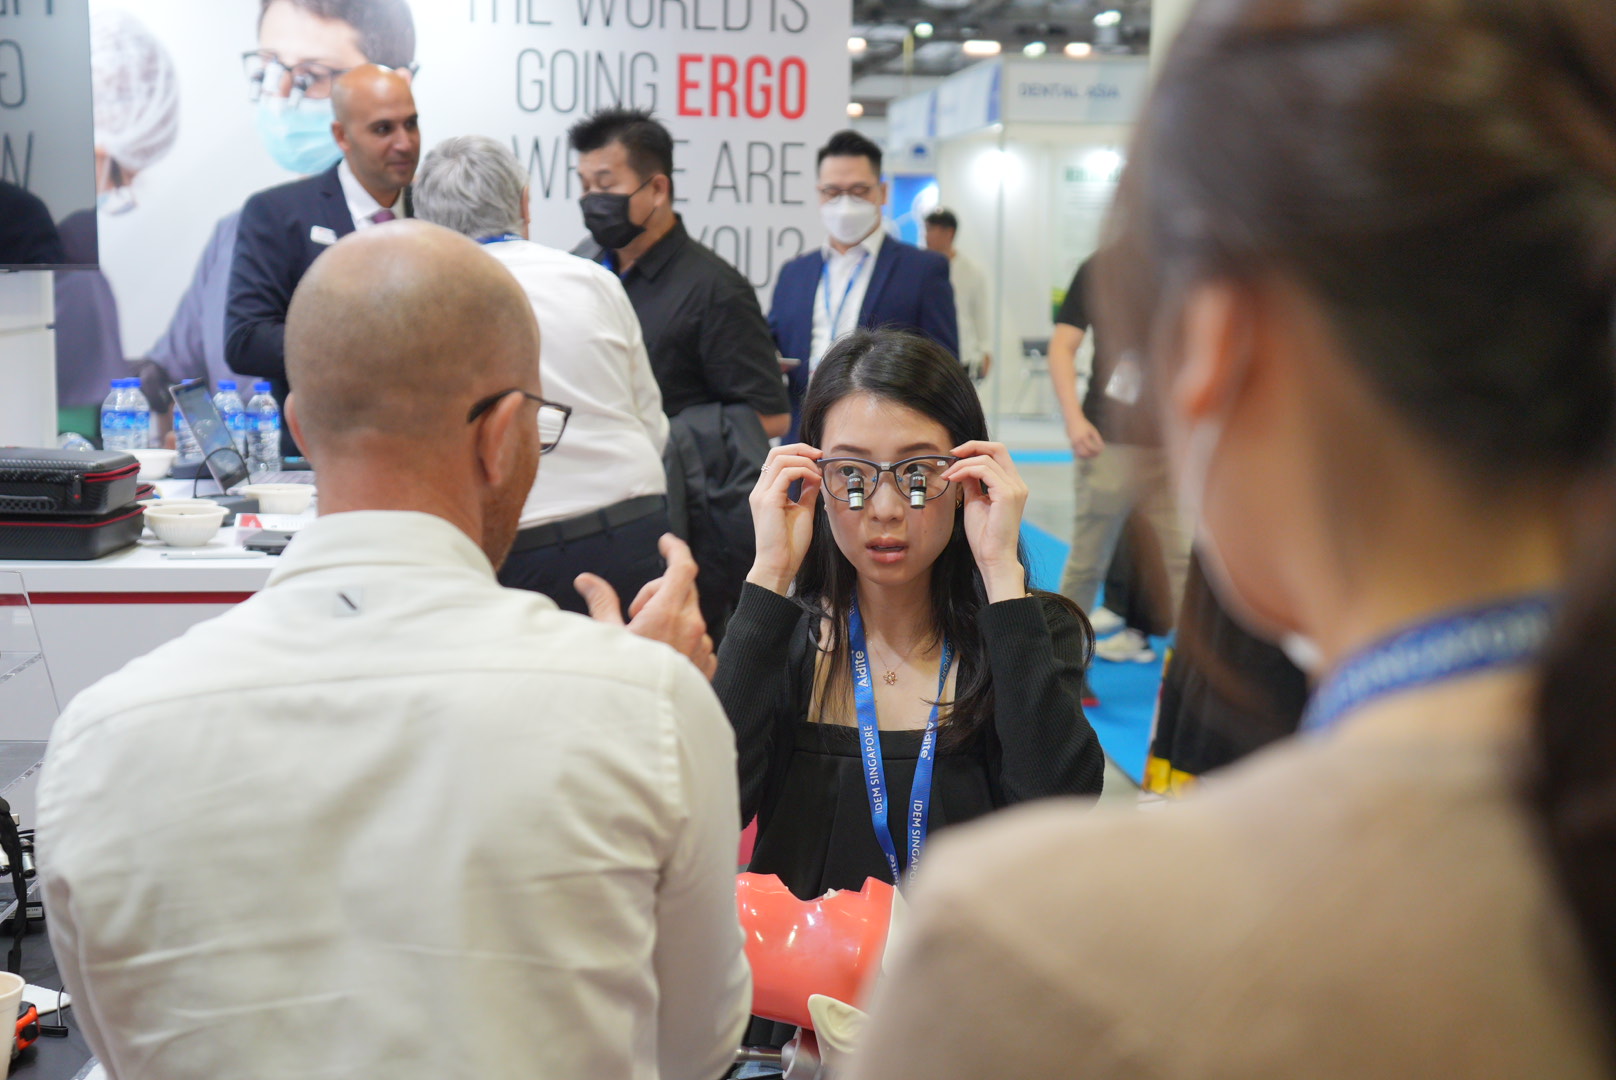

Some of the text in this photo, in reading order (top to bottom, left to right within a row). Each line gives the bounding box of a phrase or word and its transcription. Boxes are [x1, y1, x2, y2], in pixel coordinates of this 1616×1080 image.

[516, 49, 807, 120] GOING ERGO
[708, 140, 806, 205] ARE
[863, 724, 883, 815] IDEM SINGAPORE
[911, 799, 923, 828] IDEM
